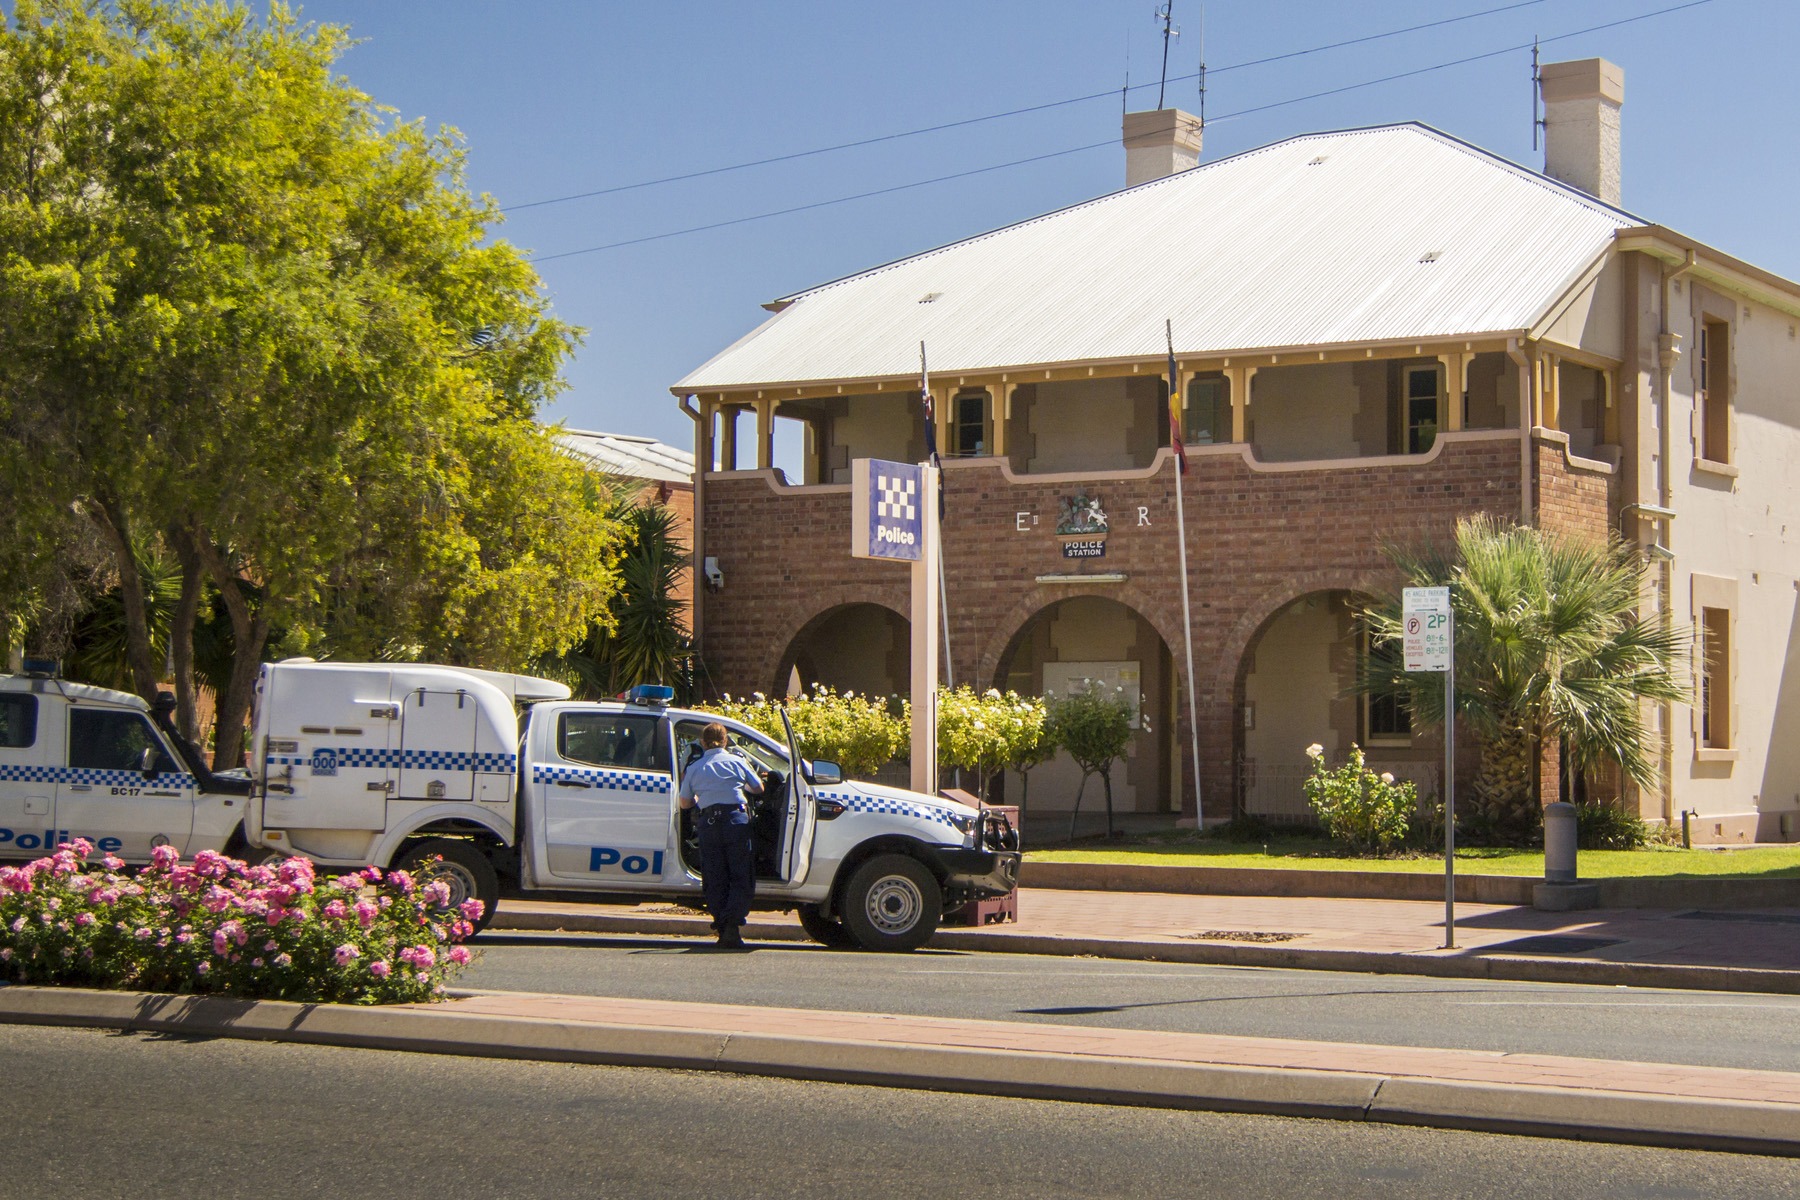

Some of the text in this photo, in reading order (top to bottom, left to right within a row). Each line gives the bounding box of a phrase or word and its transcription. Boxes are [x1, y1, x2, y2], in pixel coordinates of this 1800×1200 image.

[1137, 506, 1152, 526] R
[877, 524, 915, 545] Police
[1065, 541, 1103, 549] POLICE
[1068, 549, 1102, 557] STATION
[1428, 589, 1447, 597] PARKING
[1427, 614, 1447, 629] 2P
[312, 757, 337, 769] 000
[111, 787, 141, 796] BC17
[589, 847, 664, 875] Pol
